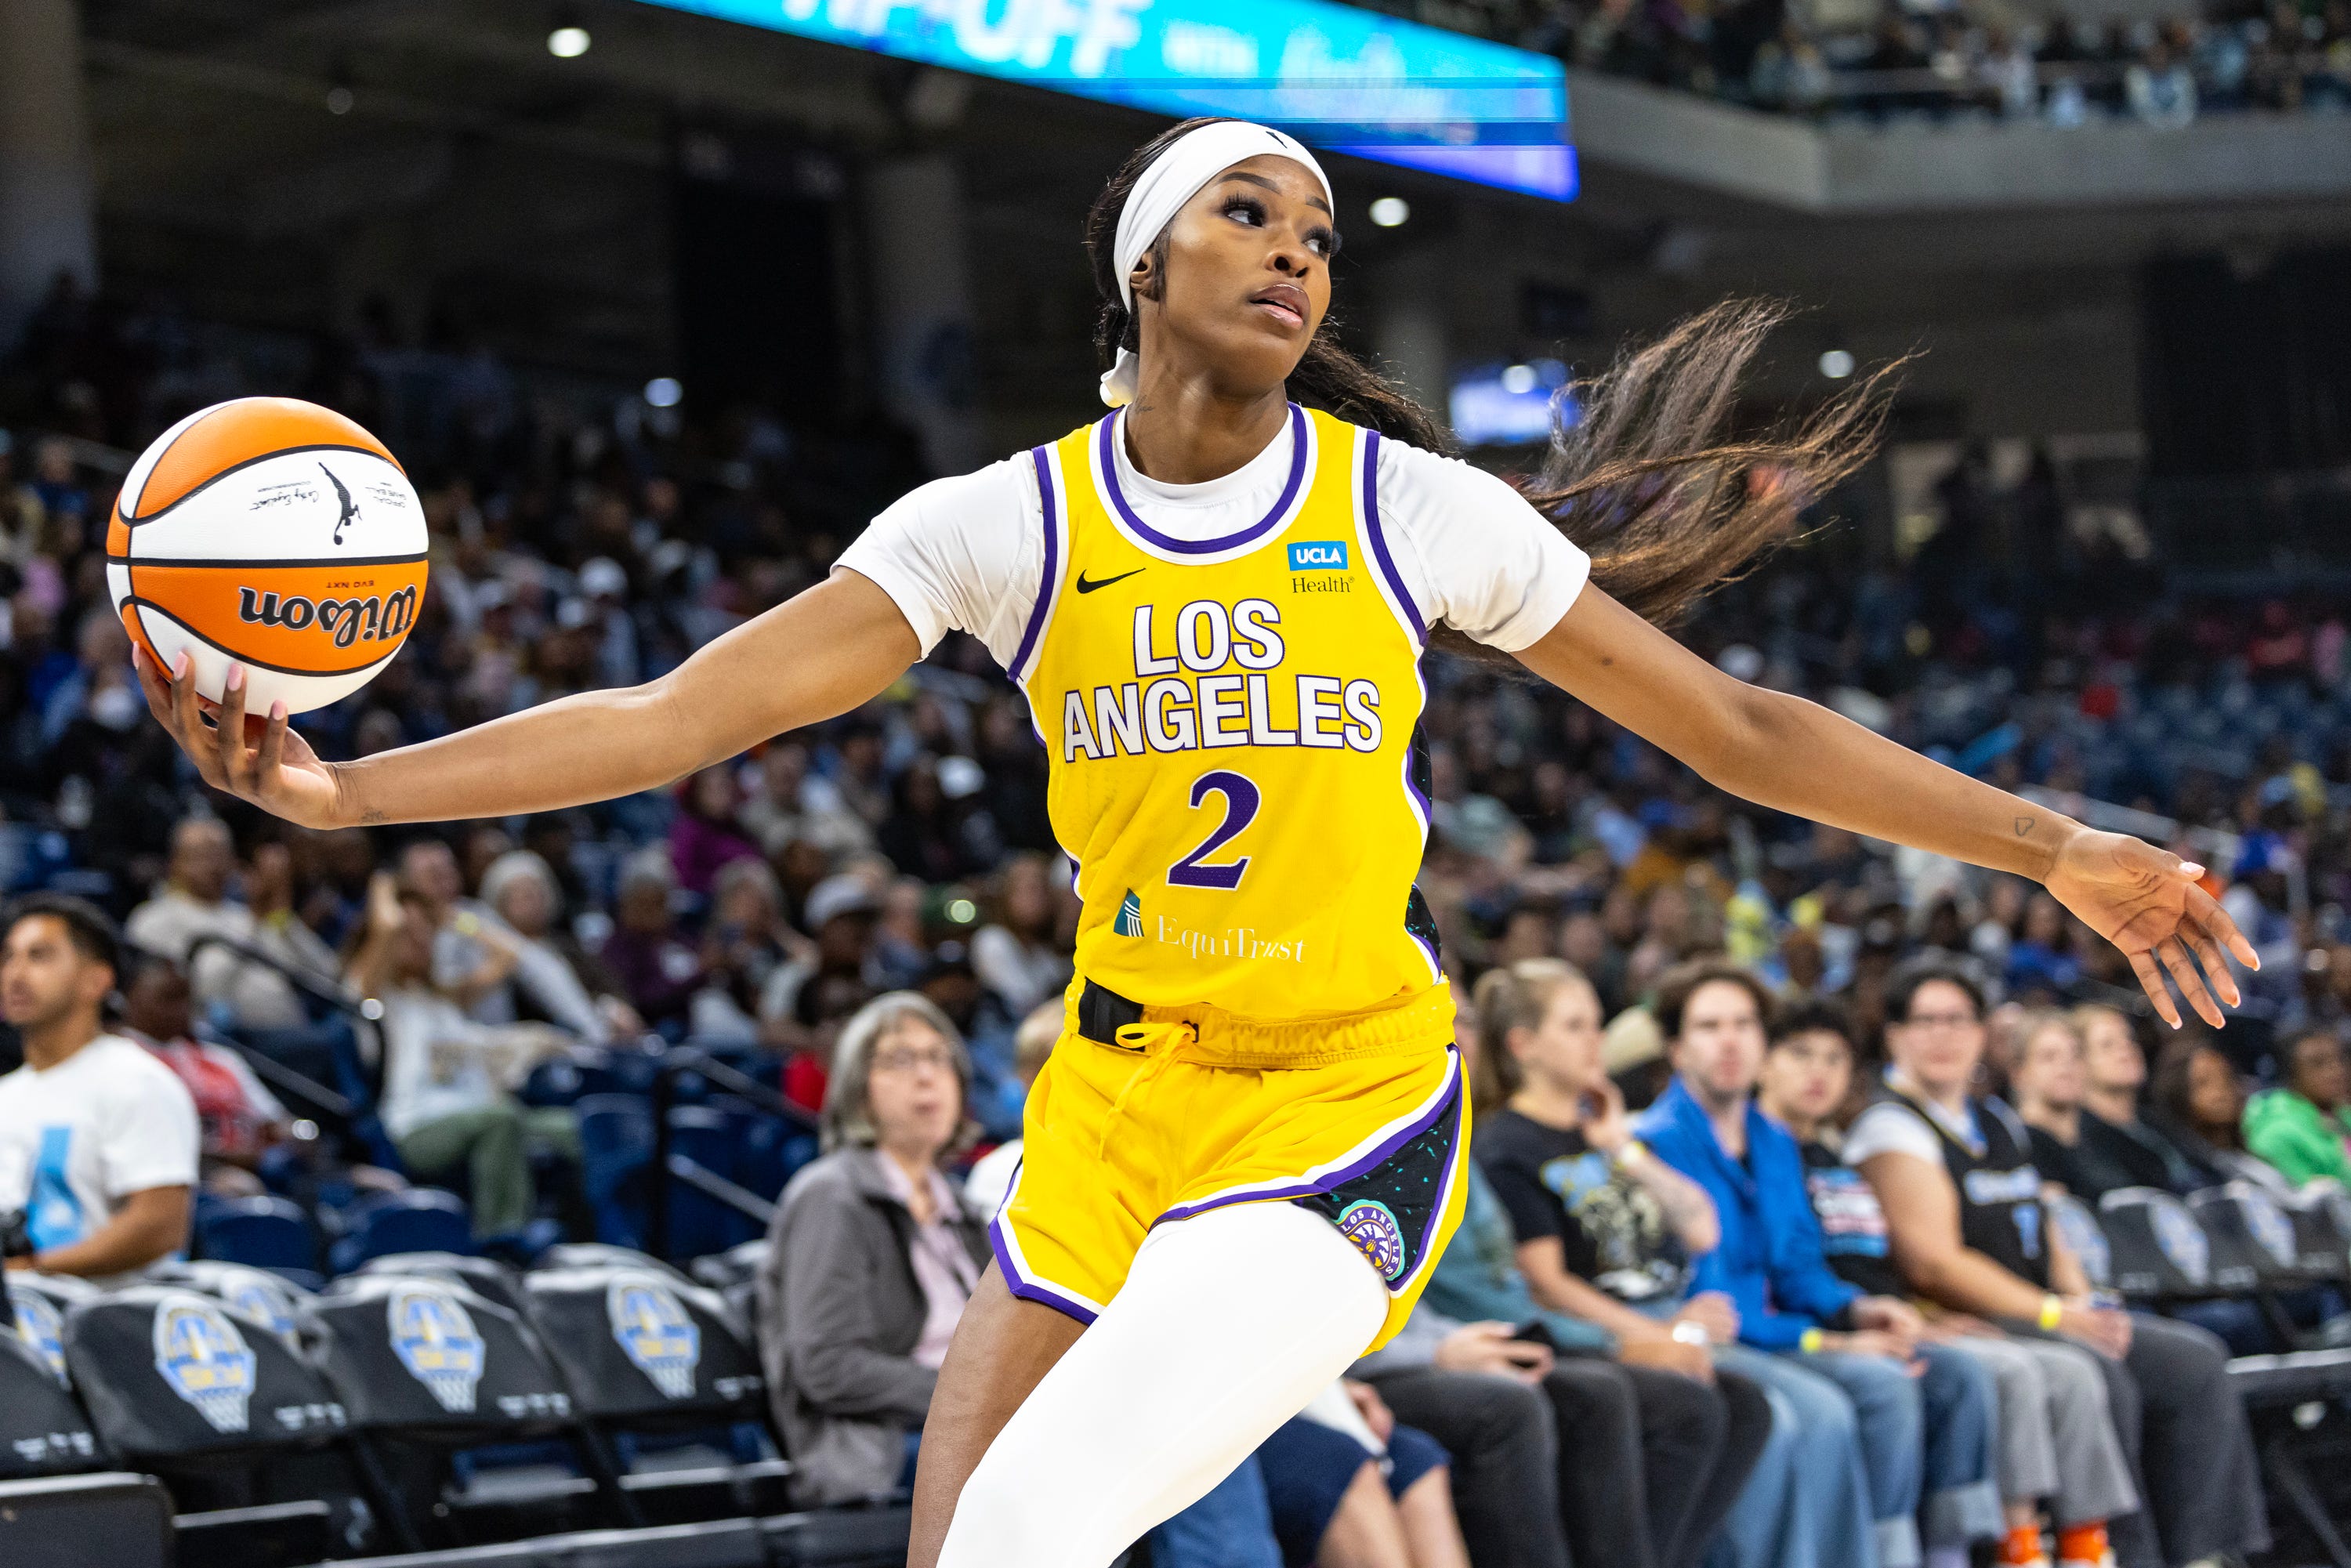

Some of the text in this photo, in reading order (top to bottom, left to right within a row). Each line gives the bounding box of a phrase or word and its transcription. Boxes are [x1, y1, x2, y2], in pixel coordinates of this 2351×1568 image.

[1295, 547, 1342, 564] UCLA
[238, 584, 417, 648] Wilson
[1134, 598, 1285, 678] LOS
[1063, 674, 1382, 763] ANGELES
[1165, 769, 1262, 892] 2
[1158, 914, 1309, 964] EquiTrust
[1340, 1209, 1400, 1274] LOS ANGELES
